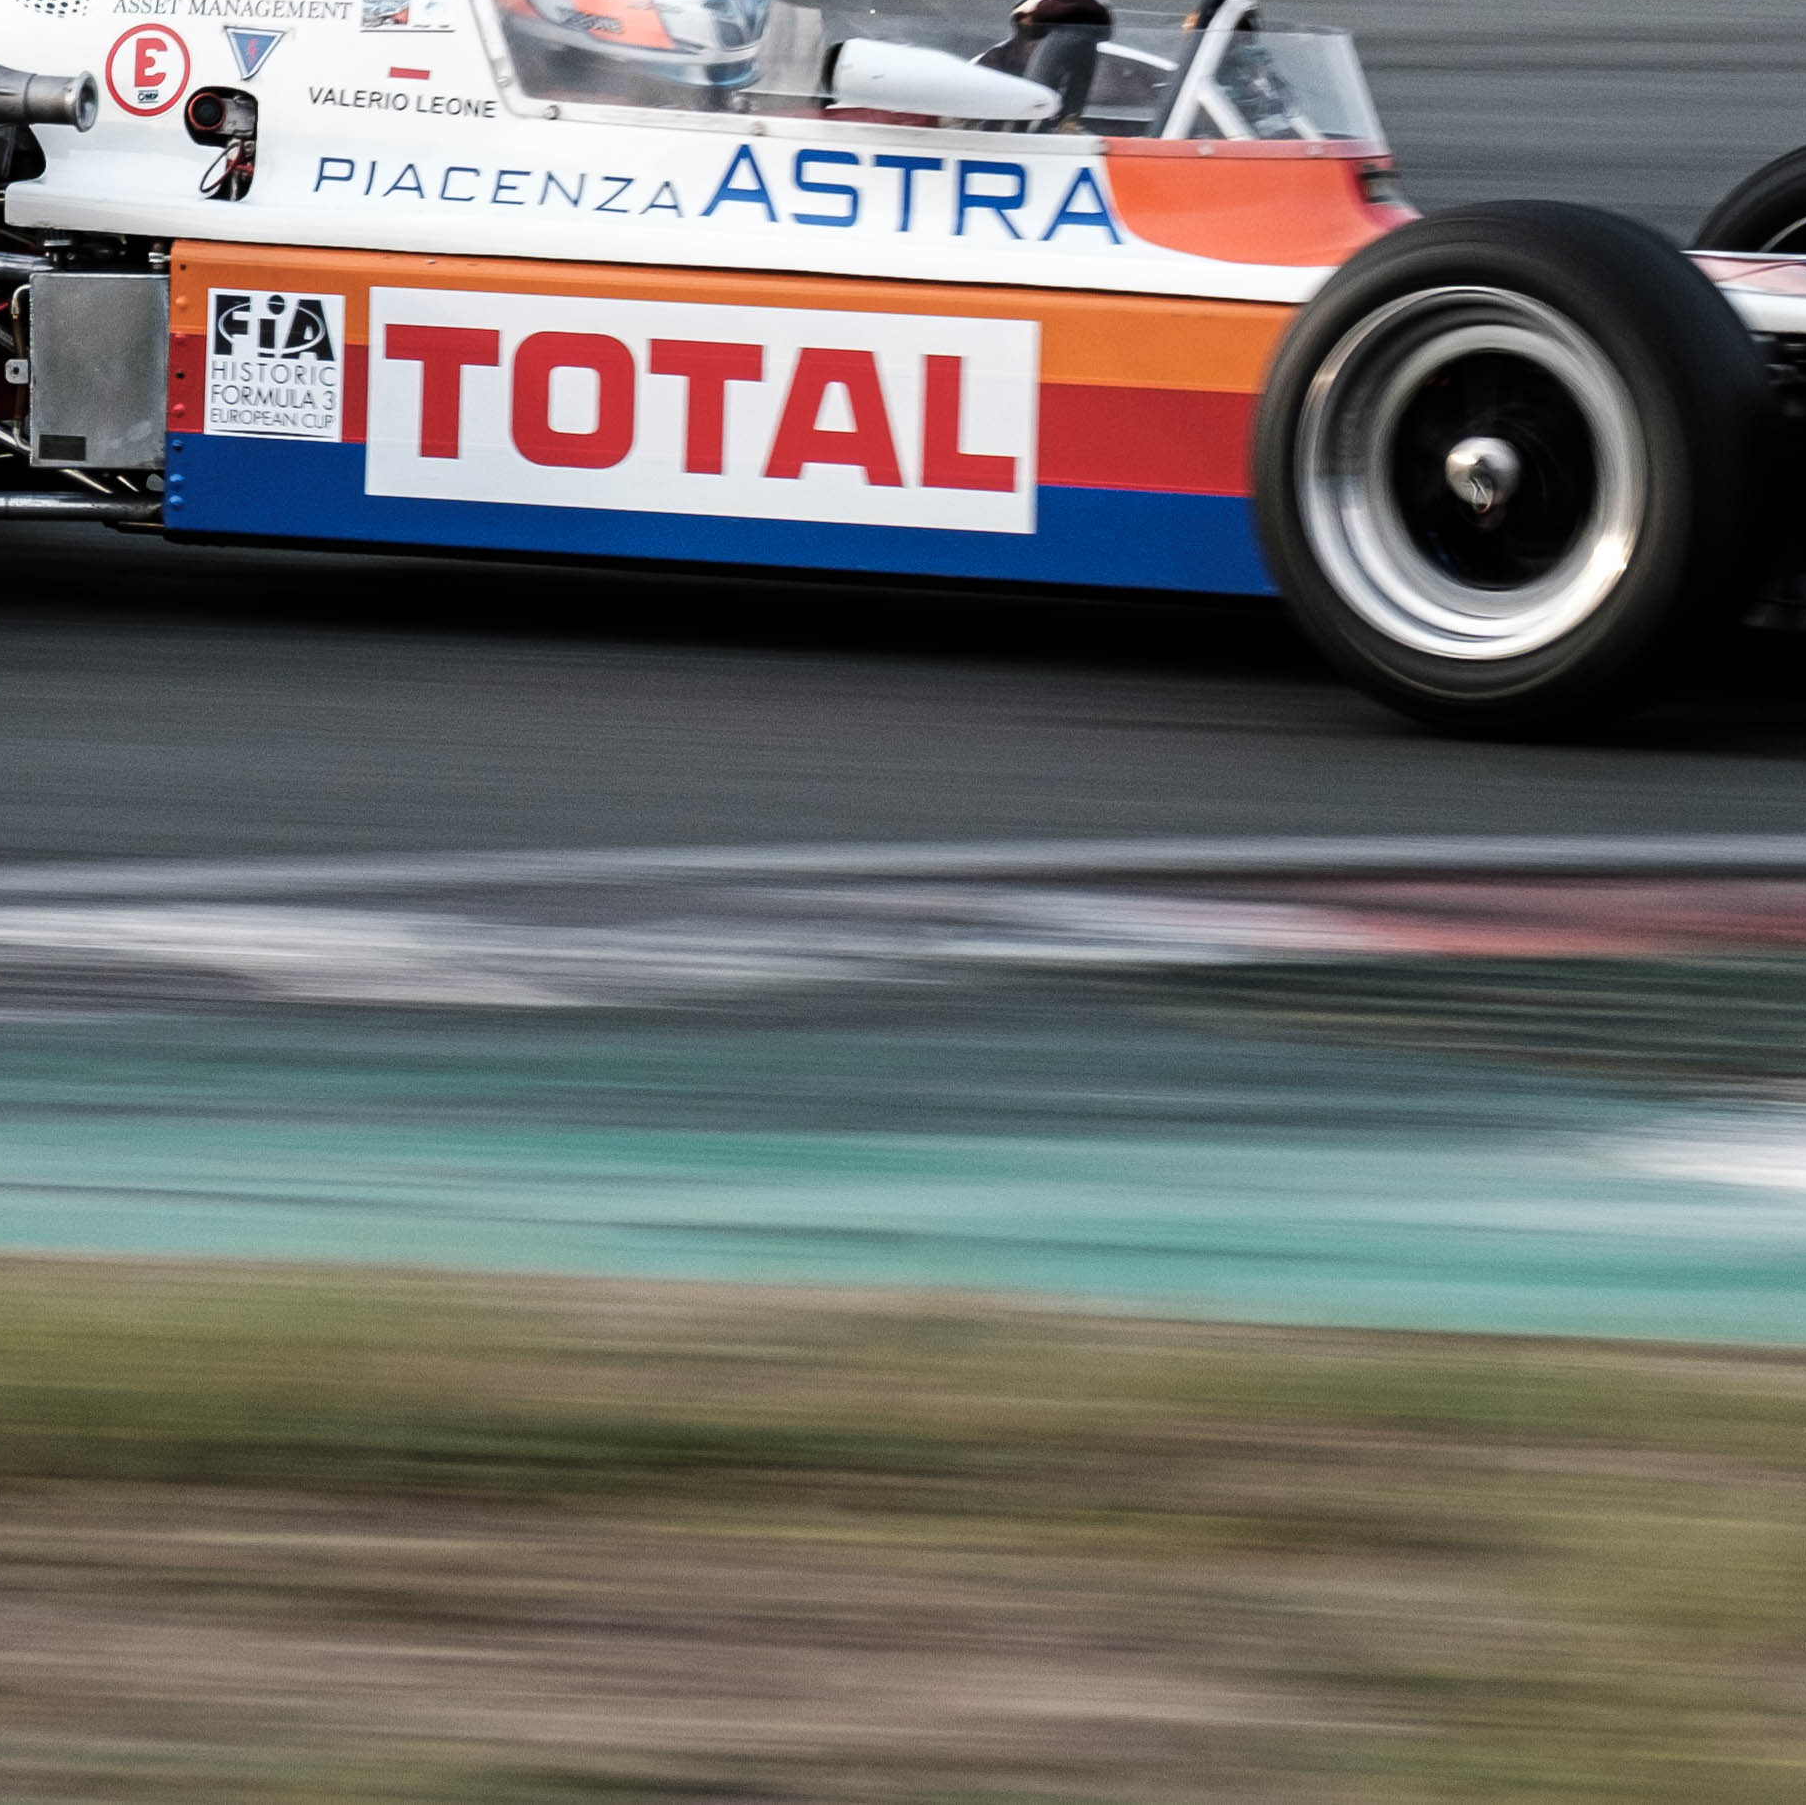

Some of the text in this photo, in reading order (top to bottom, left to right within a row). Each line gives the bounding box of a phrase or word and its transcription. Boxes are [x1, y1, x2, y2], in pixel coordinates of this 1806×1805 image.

[134, 37, 168, 88] E
[308, 86, 498, 120] VALERIO LEONE
[313, 143, 1124, 246] PIACENZA ASTRA
[210, 360, 337, 387] HISTORIC
[210, 384, 337, 411] FORMULA 3
[383, 323, 1018, 494] TOTAL
[209, 407, 335, 429] EUROPEAN CUP
